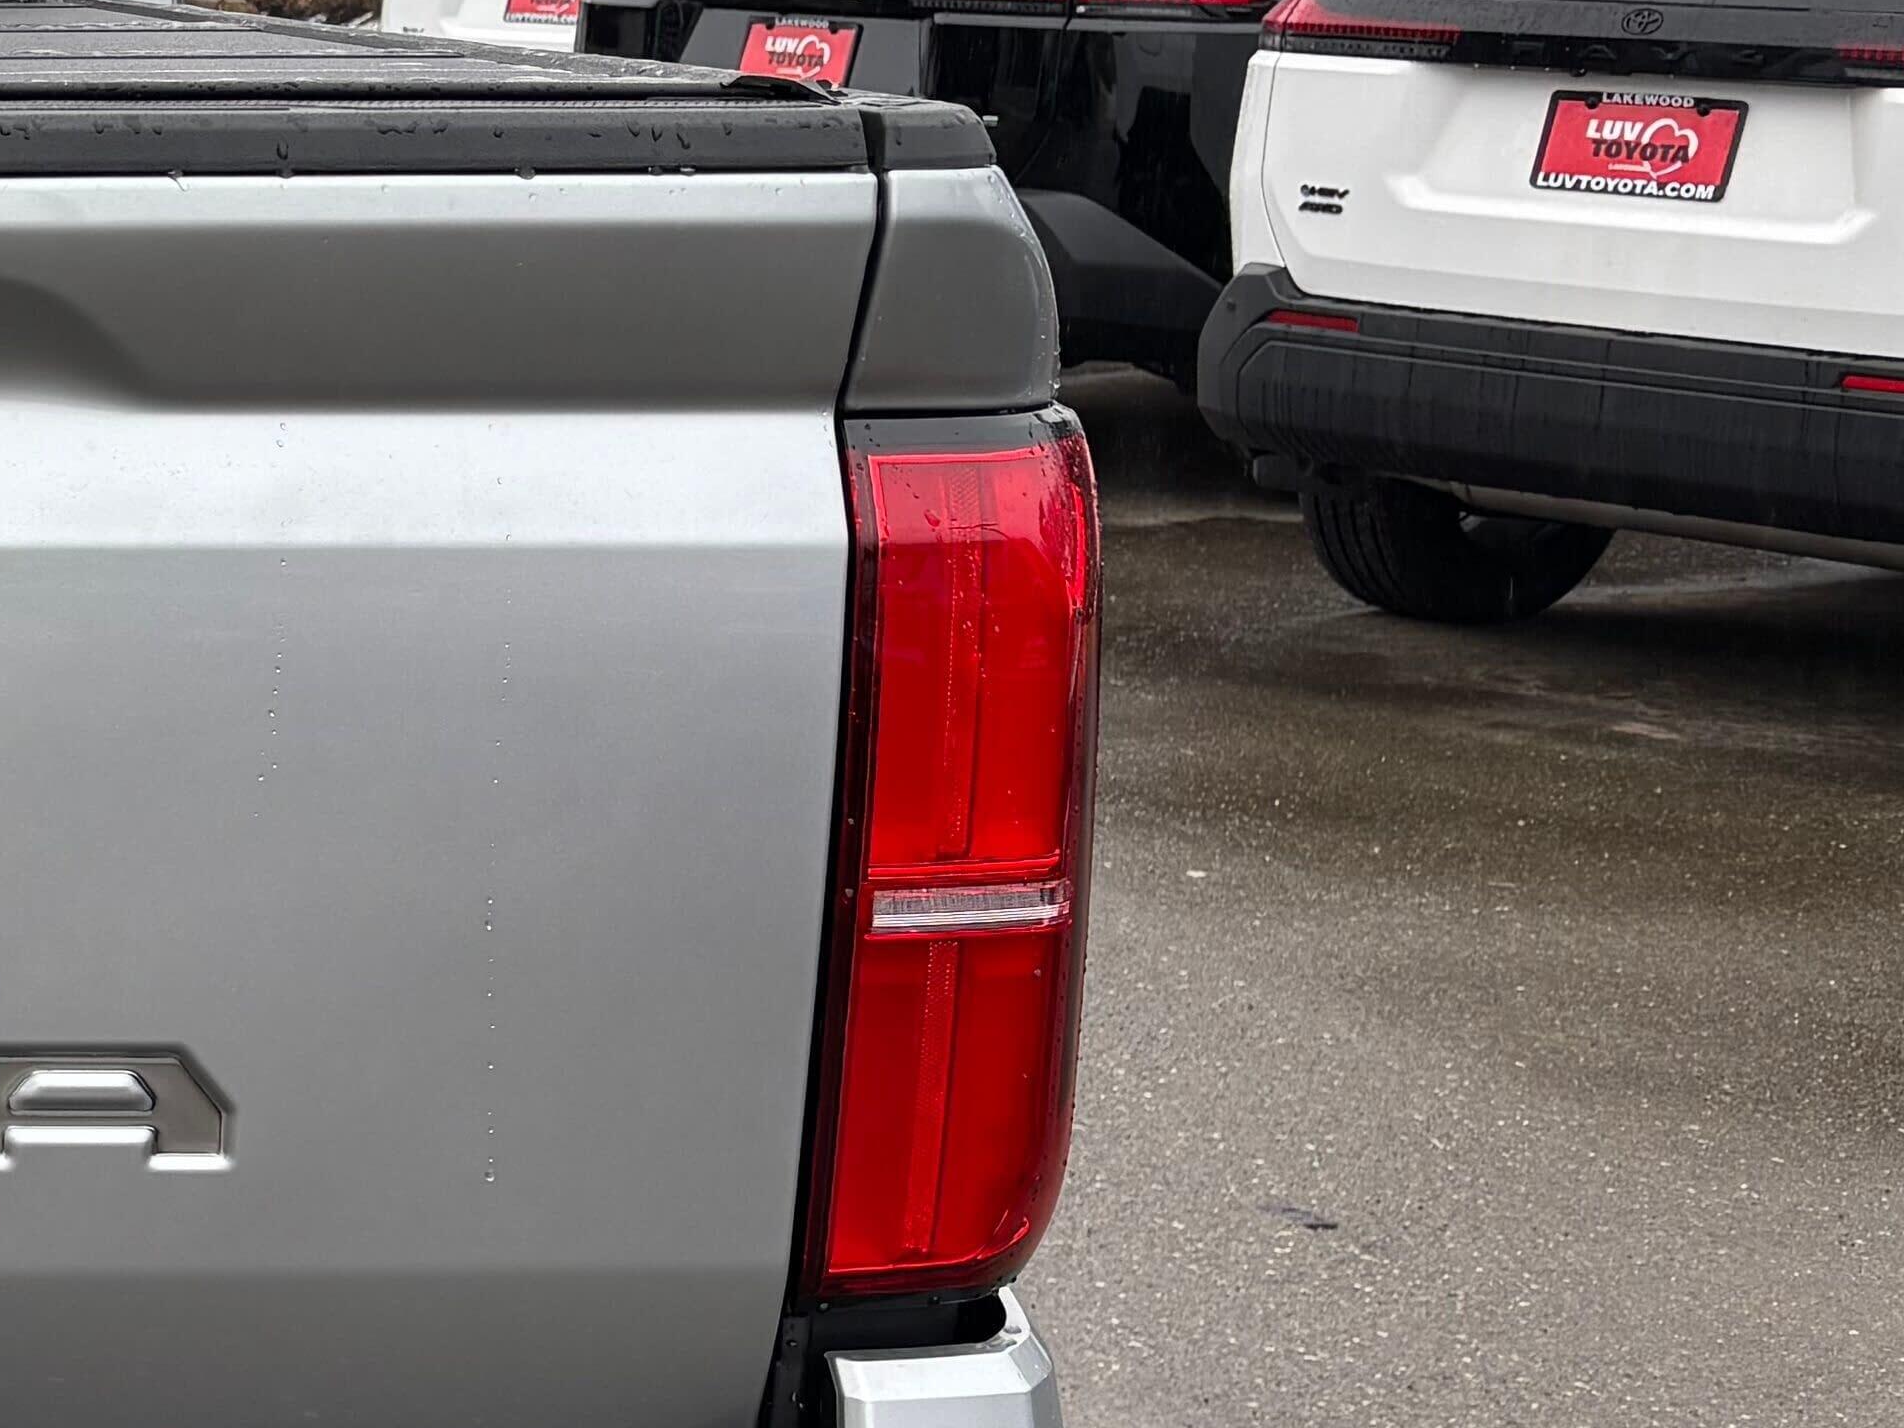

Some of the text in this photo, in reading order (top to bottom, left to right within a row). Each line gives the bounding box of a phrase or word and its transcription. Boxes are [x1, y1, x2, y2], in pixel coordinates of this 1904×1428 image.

[765, 35, 800, 54] LUV
[768, 51, 825, 68] TOYOTA
[1602, 92, 1695, 108] LAKEWOOD
[1586, 119, 1644, 142] LUV
[1592, 139, 1690, 163] TOYOTA
[1537, 172, 1715, 200] LUVTOYOTA.COM
